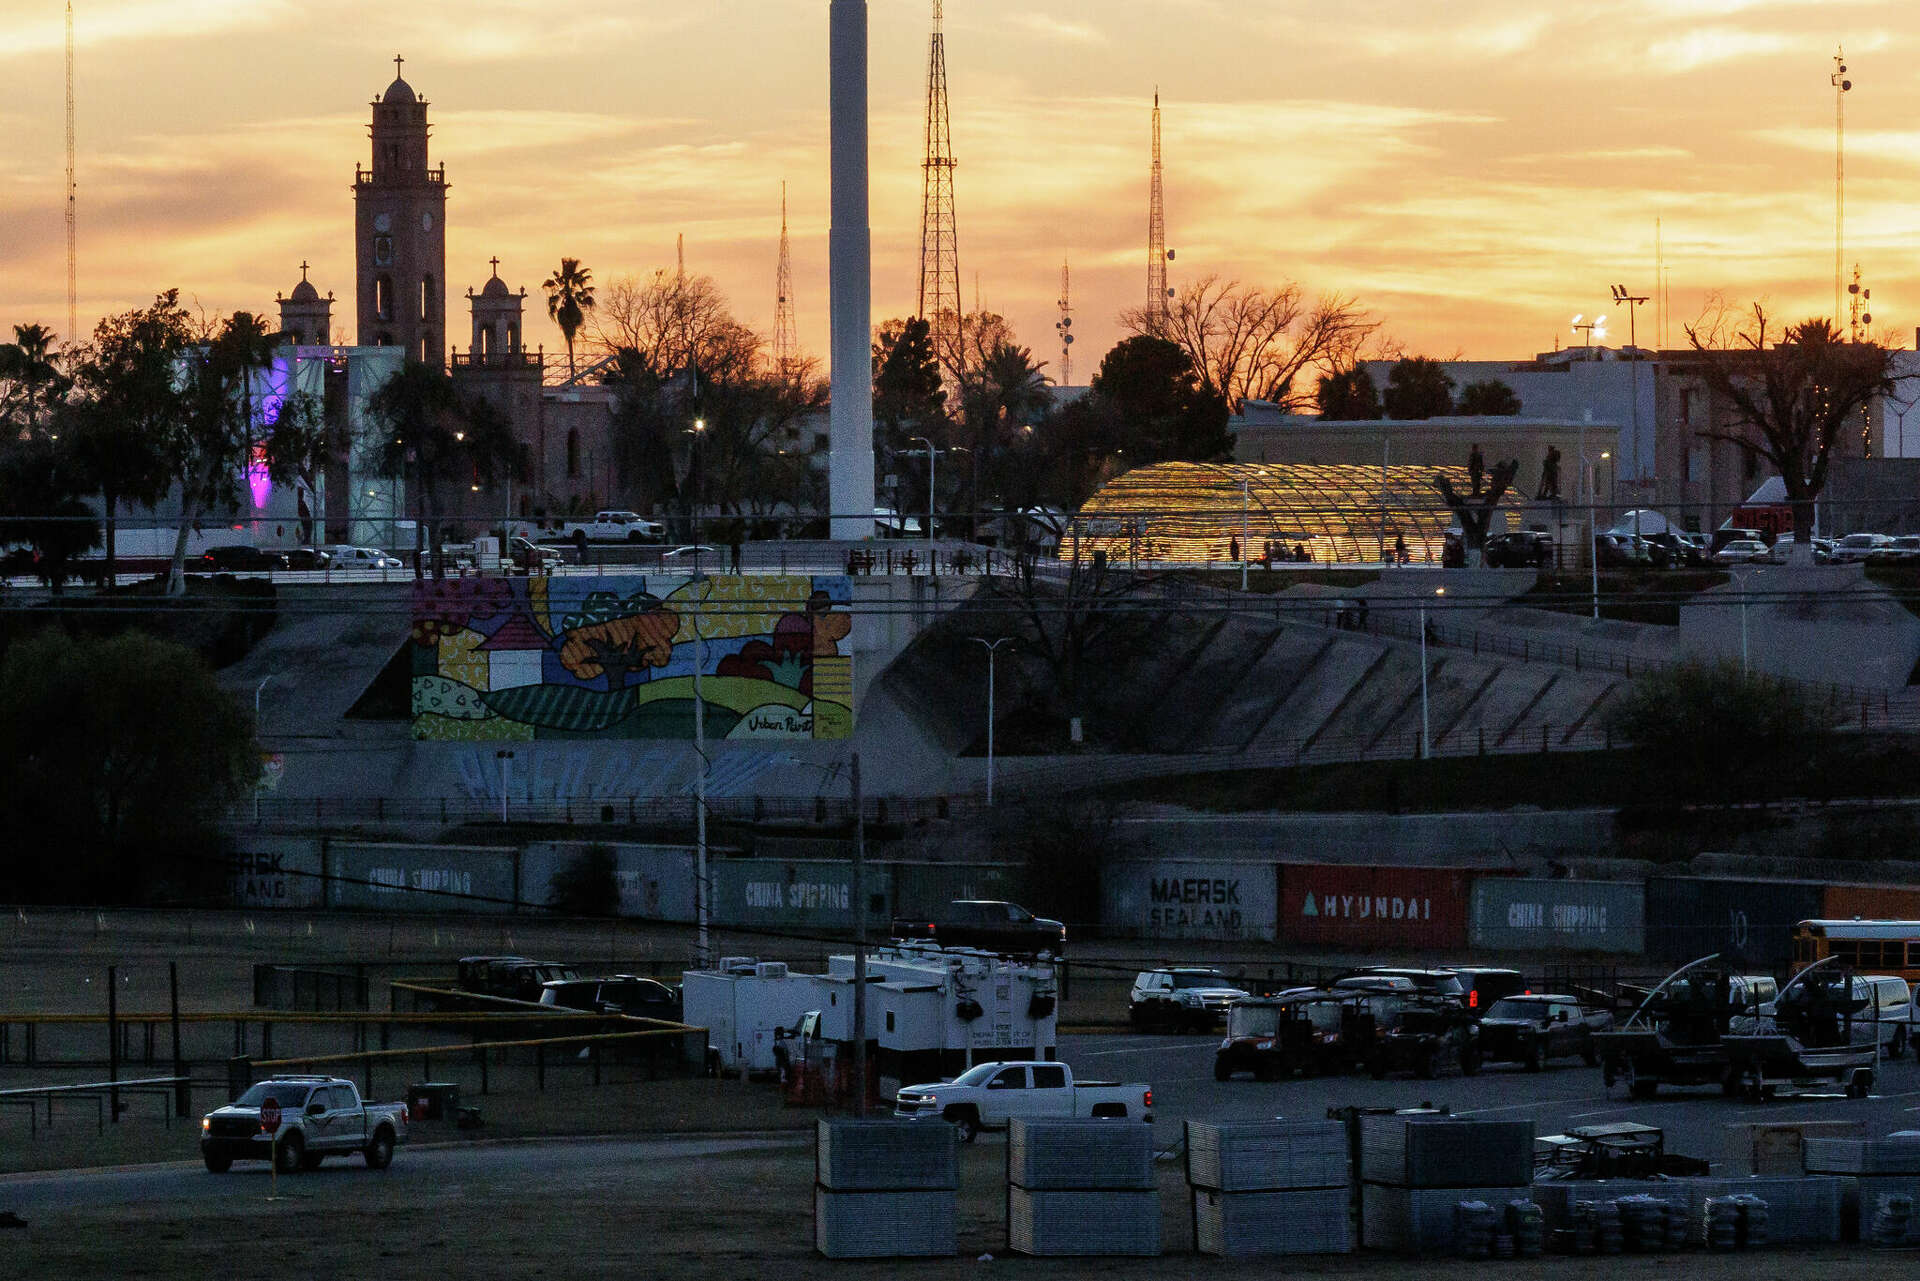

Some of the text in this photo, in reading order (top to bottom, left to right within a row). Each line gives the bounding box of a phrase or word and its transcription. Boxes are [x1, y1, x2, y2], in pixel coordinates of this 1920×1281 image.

[749, 716, 784, 731] Urban
[369, 867, 407, 893] CHINA
[412, 869, 472, 895] SHIPPING
[1151, 879, 1241, 904] MAERSK
[745, 882, 784, 907] CHINA
[789, 883, 849, 909] SHIPPING
[1324, 895, 1431, 920] HYUNDAI
[1508, 902, 1544, 929] CHINA
[1552, 904, 1607, 933] SHIPPING
[262, 1108, 280, 1121] STOP
